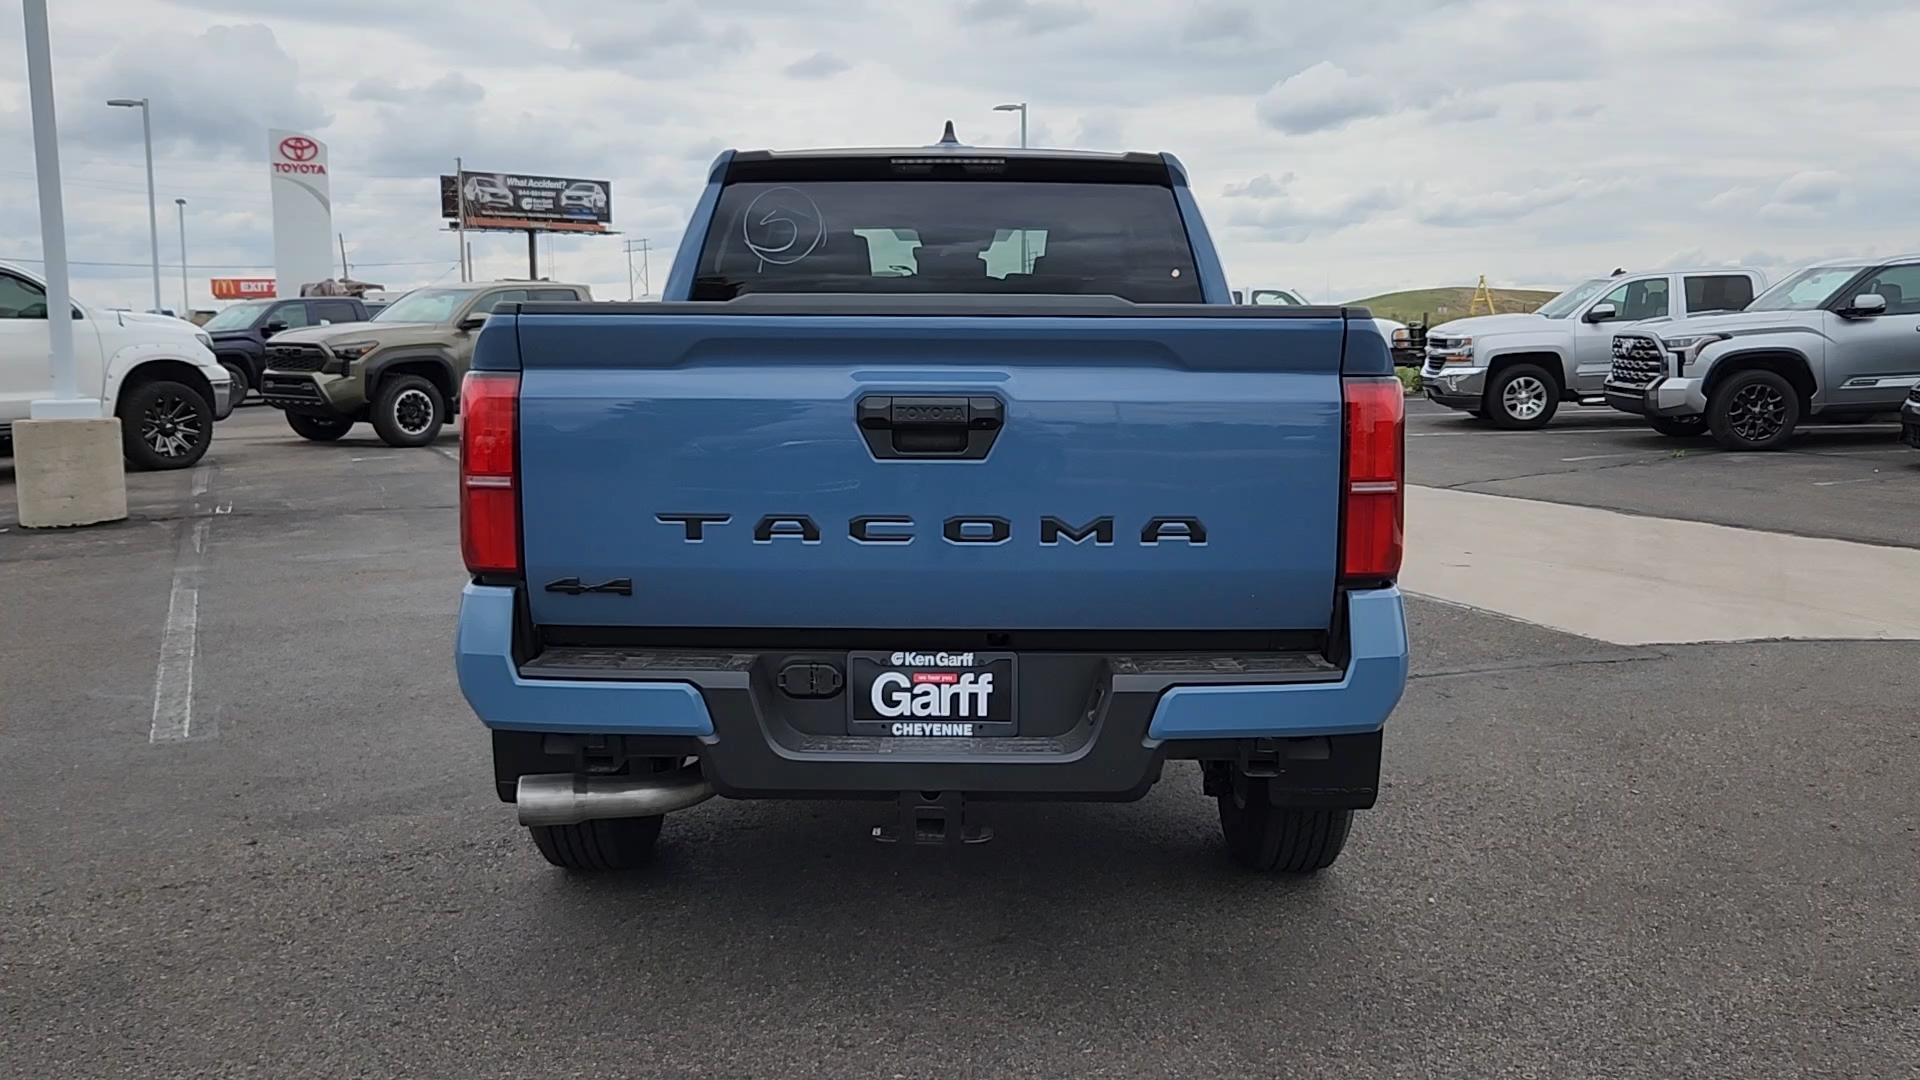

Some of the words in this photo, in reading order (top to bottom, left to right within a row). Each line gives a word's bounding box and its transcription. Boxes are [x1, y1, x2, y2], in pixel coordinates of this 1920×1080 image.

[273, 162, 326, 175] TOYOTA
[506, 177, 527, 187] What
[528, 179, 567, 190] Accident?
[240, 281, 268, 293] EXIT
[895, 406, 965, 420] TOYOTA
[654, 513, 1208, 547] TACOMA
[904, 652, 935, 666] Ken
[935, 652, 974, 667] Garff
[871, 671, 993, 717] Garff
[892, 723, 973, 736] CHEYENNE
